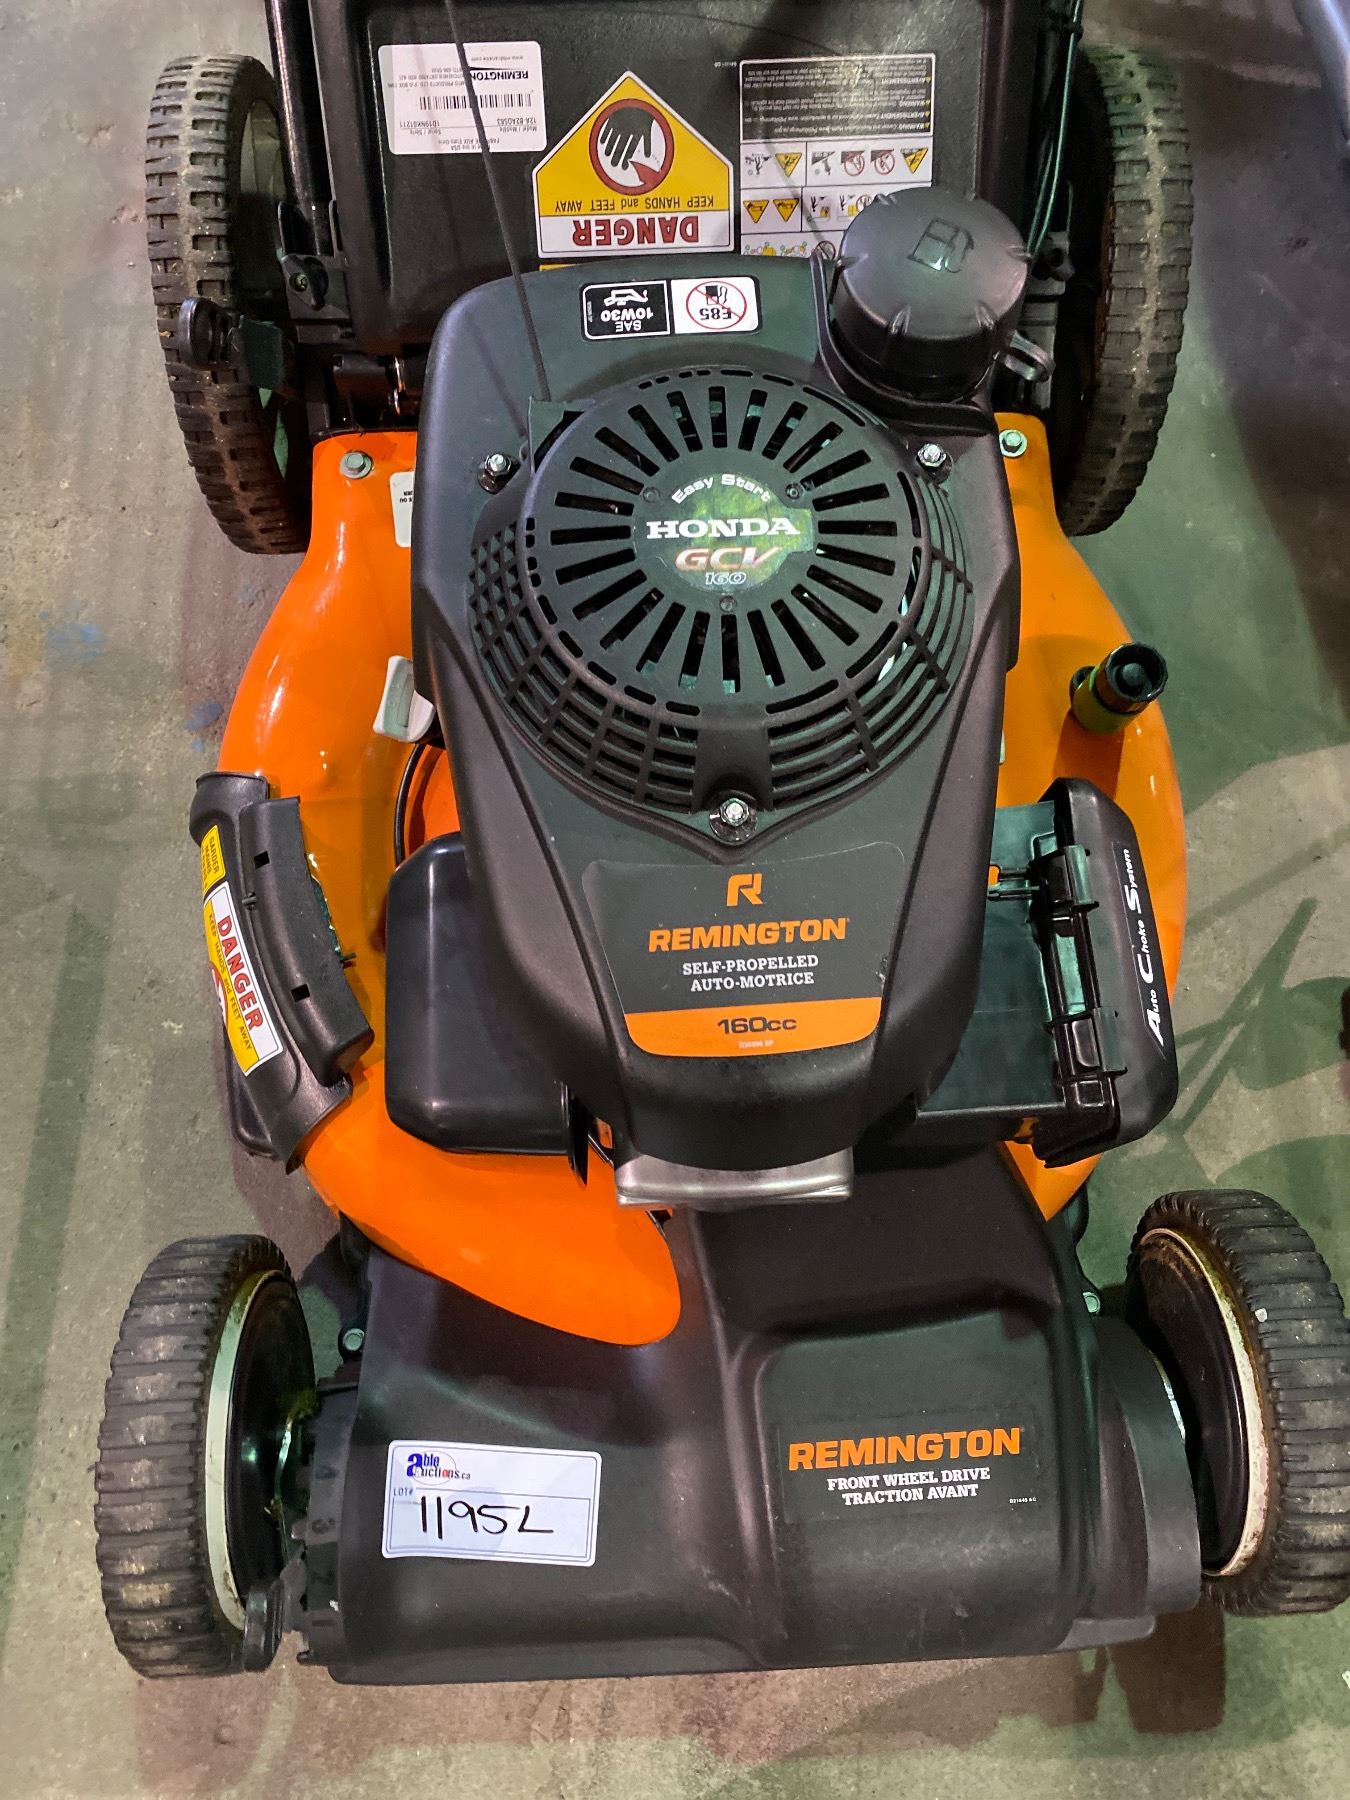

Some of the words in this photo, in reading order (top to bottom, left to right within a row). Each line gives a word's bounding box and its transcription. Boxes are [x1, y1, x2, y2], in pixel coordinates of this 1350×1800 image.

[555, 200, 582, 213] AWAY
[590, 199, 615, 211] FEET
[621, 198, 639, 209] and
[645, 196, 680, 209] HANDS
[687, 195, 714, 208] KEEP
[572, 215, 699, 246] DANGER
[600, 307, 653, 322] 10W30
[699, 307, 732, 321] E85
[615, 319, 642, 333] SAE
[671, 476, 714, 504] Easy
[721, 473, 771, 502] Start
[646, 517, 801, 540] HONDA
[674, 546, 782, 571] GCV
[705, 571, 747, 586] 160
[209, 836, 220, 875] GARDER
[1124, 849, 1142, 915] System
[648, 917, 847, 953] REMINGTON
[1137, 919, 1154, 984] Choke
[217, 914, 264, 1032] DANGER
[682, 954, 819, 976] SELF-PROPELLED
[690, 971, 815, 993] AUTO-MOTRICE
[214, 941, 227, 974] HANDS
[223, 978, 232, 994] and
[230, 997, 241, 1021] FEET
[238, 1025, 252, 1051] AWAY
[717, 1016, 798, 1035] 160cc
[1147, 988, 1164, 1047] Auto
[788, 1427, 1021, 1472] REMINGTON
[827, 1475, 879, 1491] FRONT
[883, 1470, 938, 1487] WHEEL
[941, 1467, 991, 1483] DRIVE
[842, 1487, 924, 1506] TRACTION
[927, 1484, 979, 1500] AVANT
